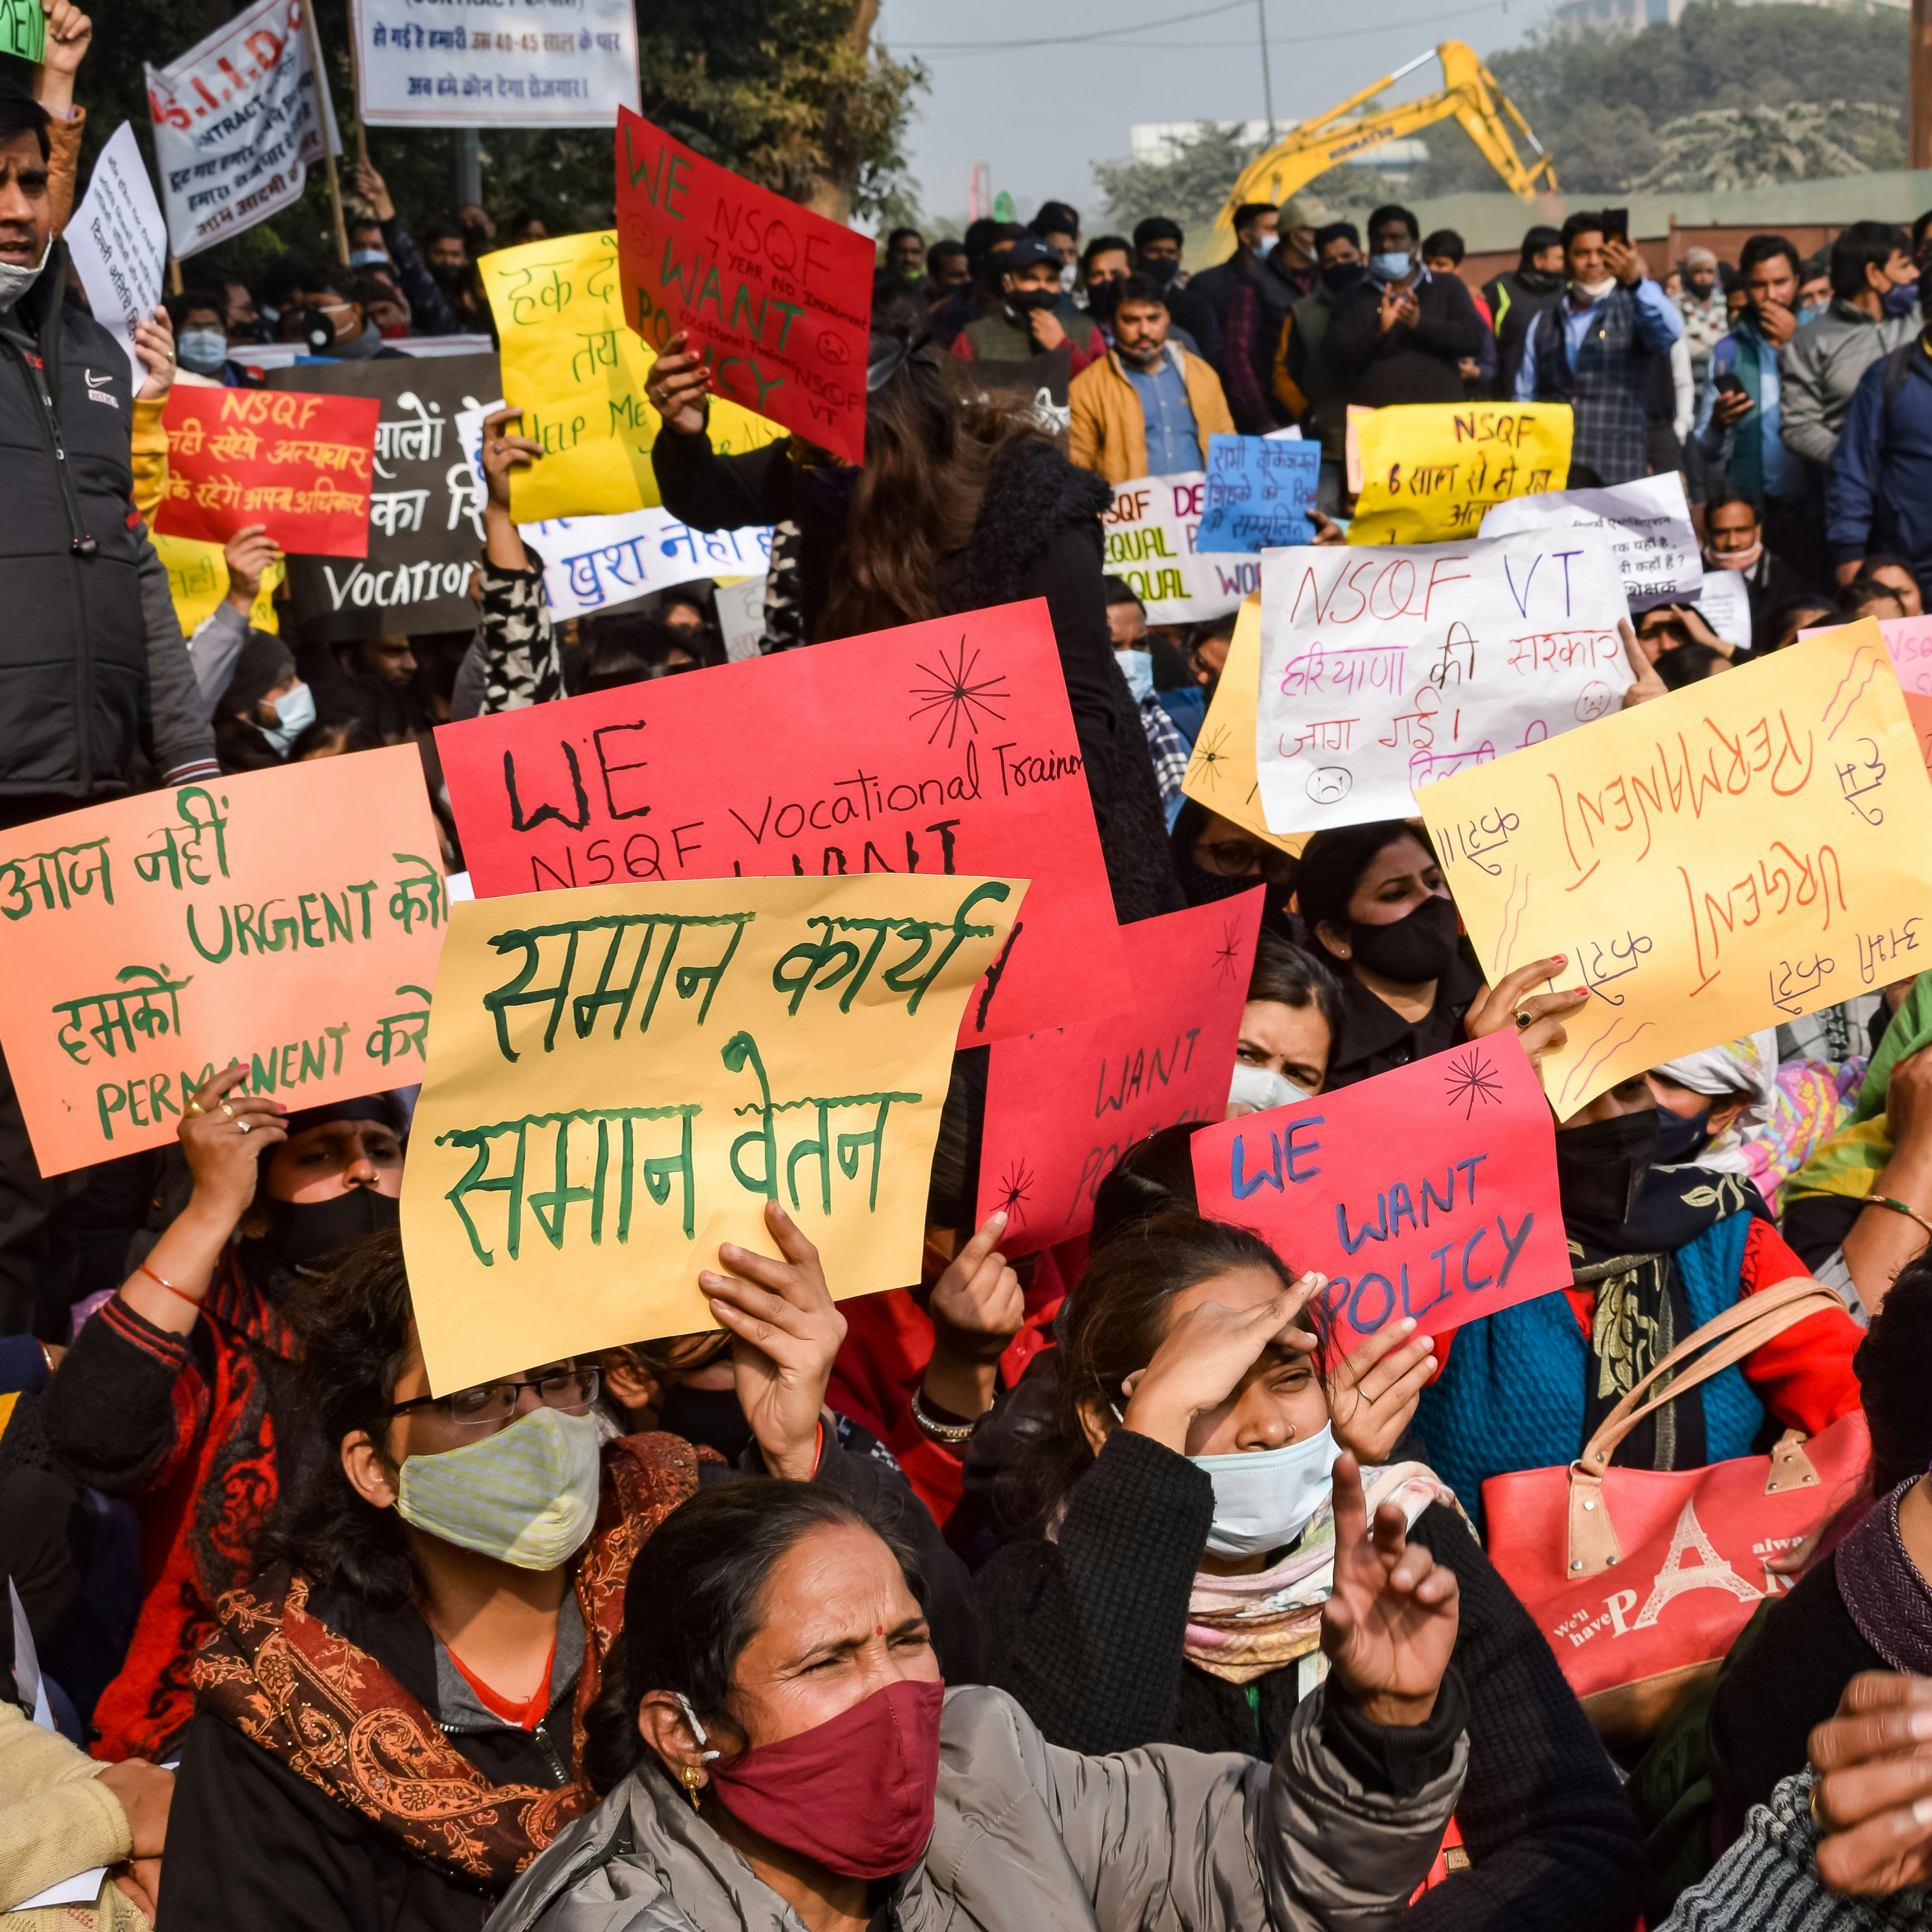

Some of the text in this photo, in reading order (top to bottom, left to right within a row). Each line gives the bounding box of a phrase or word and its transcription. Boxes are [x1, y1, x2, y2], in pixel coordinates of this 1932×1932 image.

[624, 123, 694, 220] WE
[714, 197, 831, 288] NSQF
[728, 250, 764, 285] YEAR
[660, 236, 807, 352] WANT
[637, 284, 784, 410] POICY
[221, 392, 324, 429] NSQF
[1454, 411, 1536, 449] NSQF
[1290, 550, 1584, 626] NSQF VT
[1280, 621, 1624, 697] हरियाणा की सरकार
[503, 719, 652, 833] WE
[1279, 719, 1361, 758] जाग
[530, 821, 705, 892] NSQF
[728, 739, 984, 845] Vocational
[1546, 708, 1814, 892] PERMANENT
[0, 786, 231, 922] आज नहीं
[186, 879, 378, 964] URGENT
[1677, 841, 1848, 998] URGENT
[1769, 916, 1924, 1016] अभी करो
[483, 910, 756, 1063] समान
[772, 880, 1011, 1017] कार्य
[1094, 1027, 1203, 1120] WANT
[434, 1100, 703, 1267] समान
[723, 1029, 923, 1217] वेतन
[1231, 1115, 1326, 1201] WE
[1335, 1153, 1490, 1255] WANT
[1319, 1211, 1535, 1344] POLICY
[1553, 1608, 1590, 1637] we'll
[1568, 1613, 1612, 1648] have
